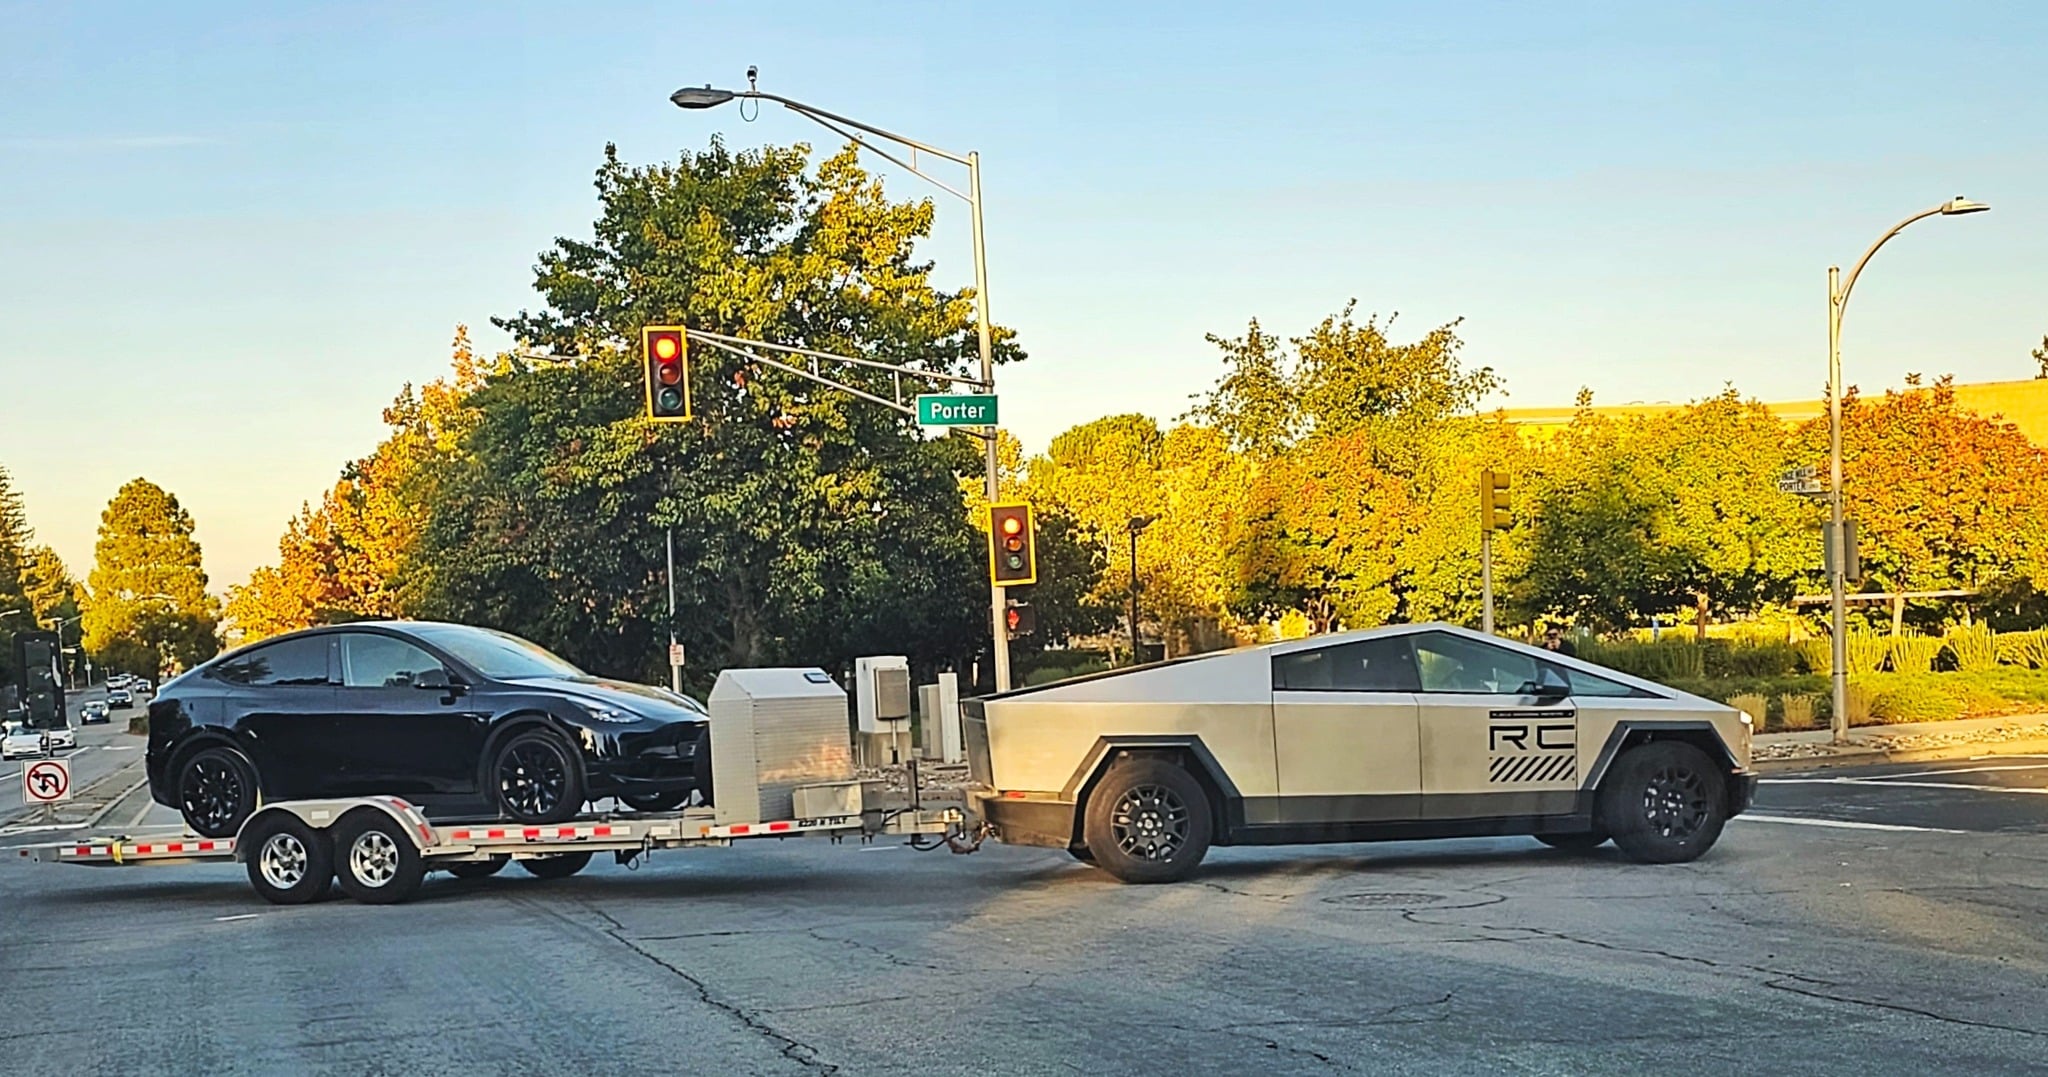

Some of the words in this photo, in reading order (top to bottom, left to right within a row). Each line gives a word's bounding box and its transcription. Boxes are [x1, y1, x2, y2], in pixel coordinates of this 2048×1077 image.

[931, 402, 986, 419] Porter
[1779, 480, 1806, 491] PORTER
[1490, 725, 1575, 751] RC
